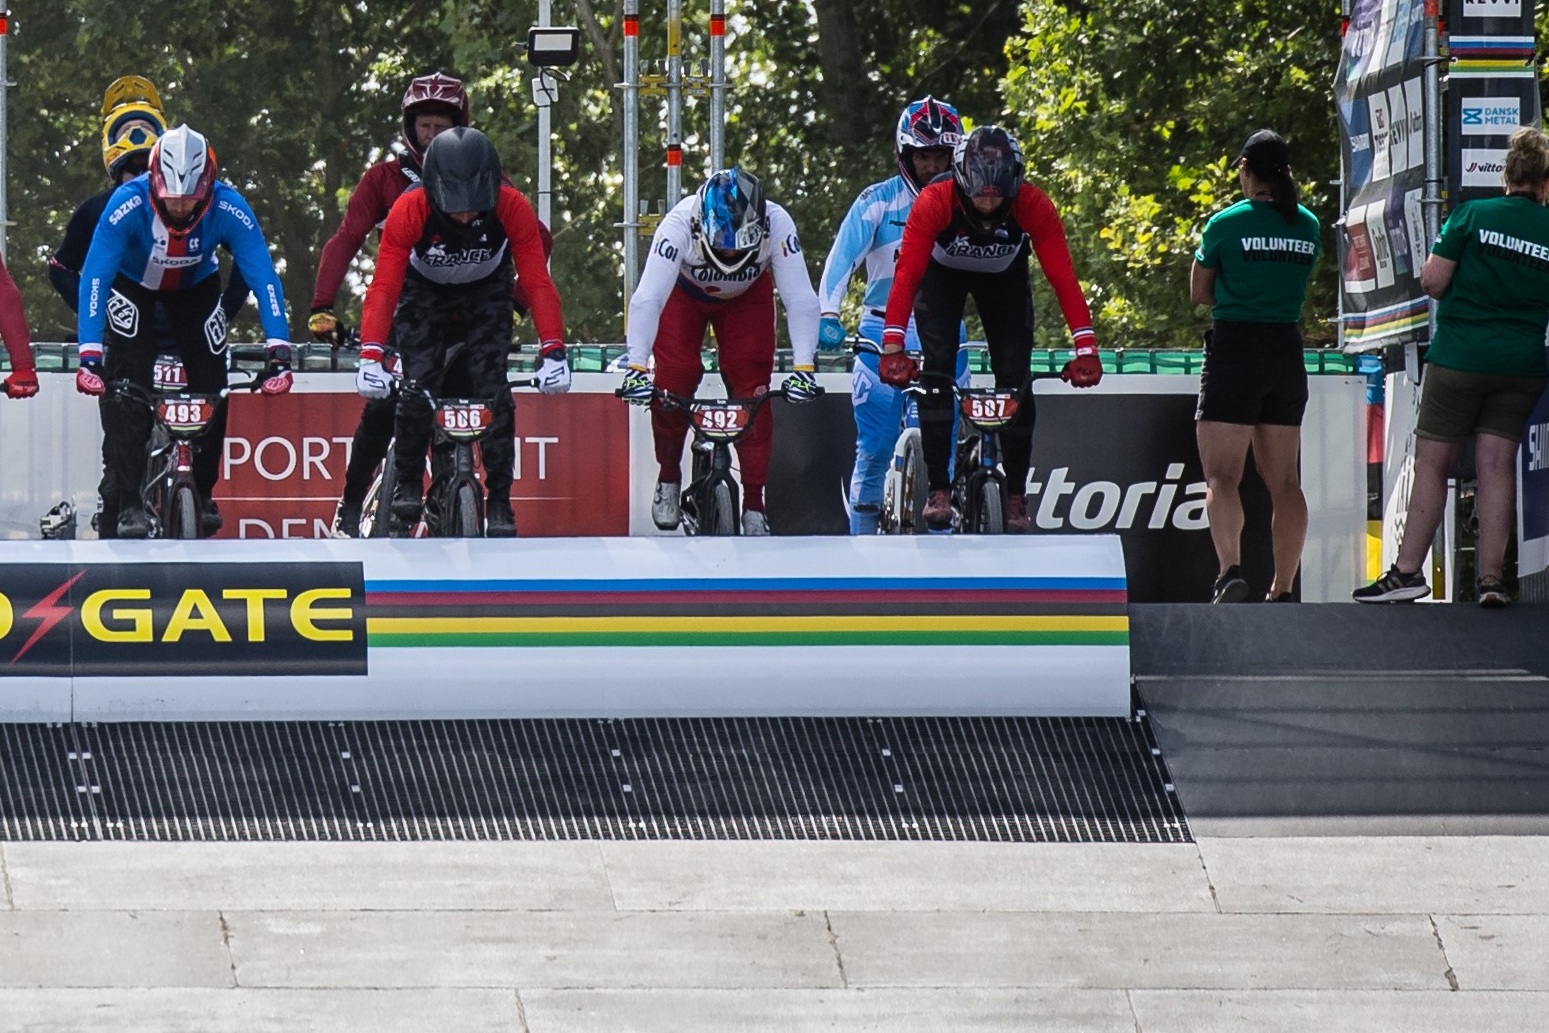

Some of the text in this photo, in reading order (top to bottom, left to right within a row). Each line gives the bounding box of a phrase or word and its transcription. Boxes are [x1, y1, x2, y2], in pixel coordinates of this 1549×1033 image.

[1484, 107, 1520, 116] DANSK
[1484, 117, 1518, 125] METAL
[1241, 237, 1315, 256] VOLUNTEER
[1479, 228, 1549, 257] VOLUNTEE
[153, 365, 181, 383] 511
[165, 405, 201, 423] 493
[972, 399, 1005, 417] 507
[444, 410, 481, 428] 506
[702, 411, 737, 428] 492
[223, 436, 353, 480] PORT
[81, 588, 353, 643] GATE
